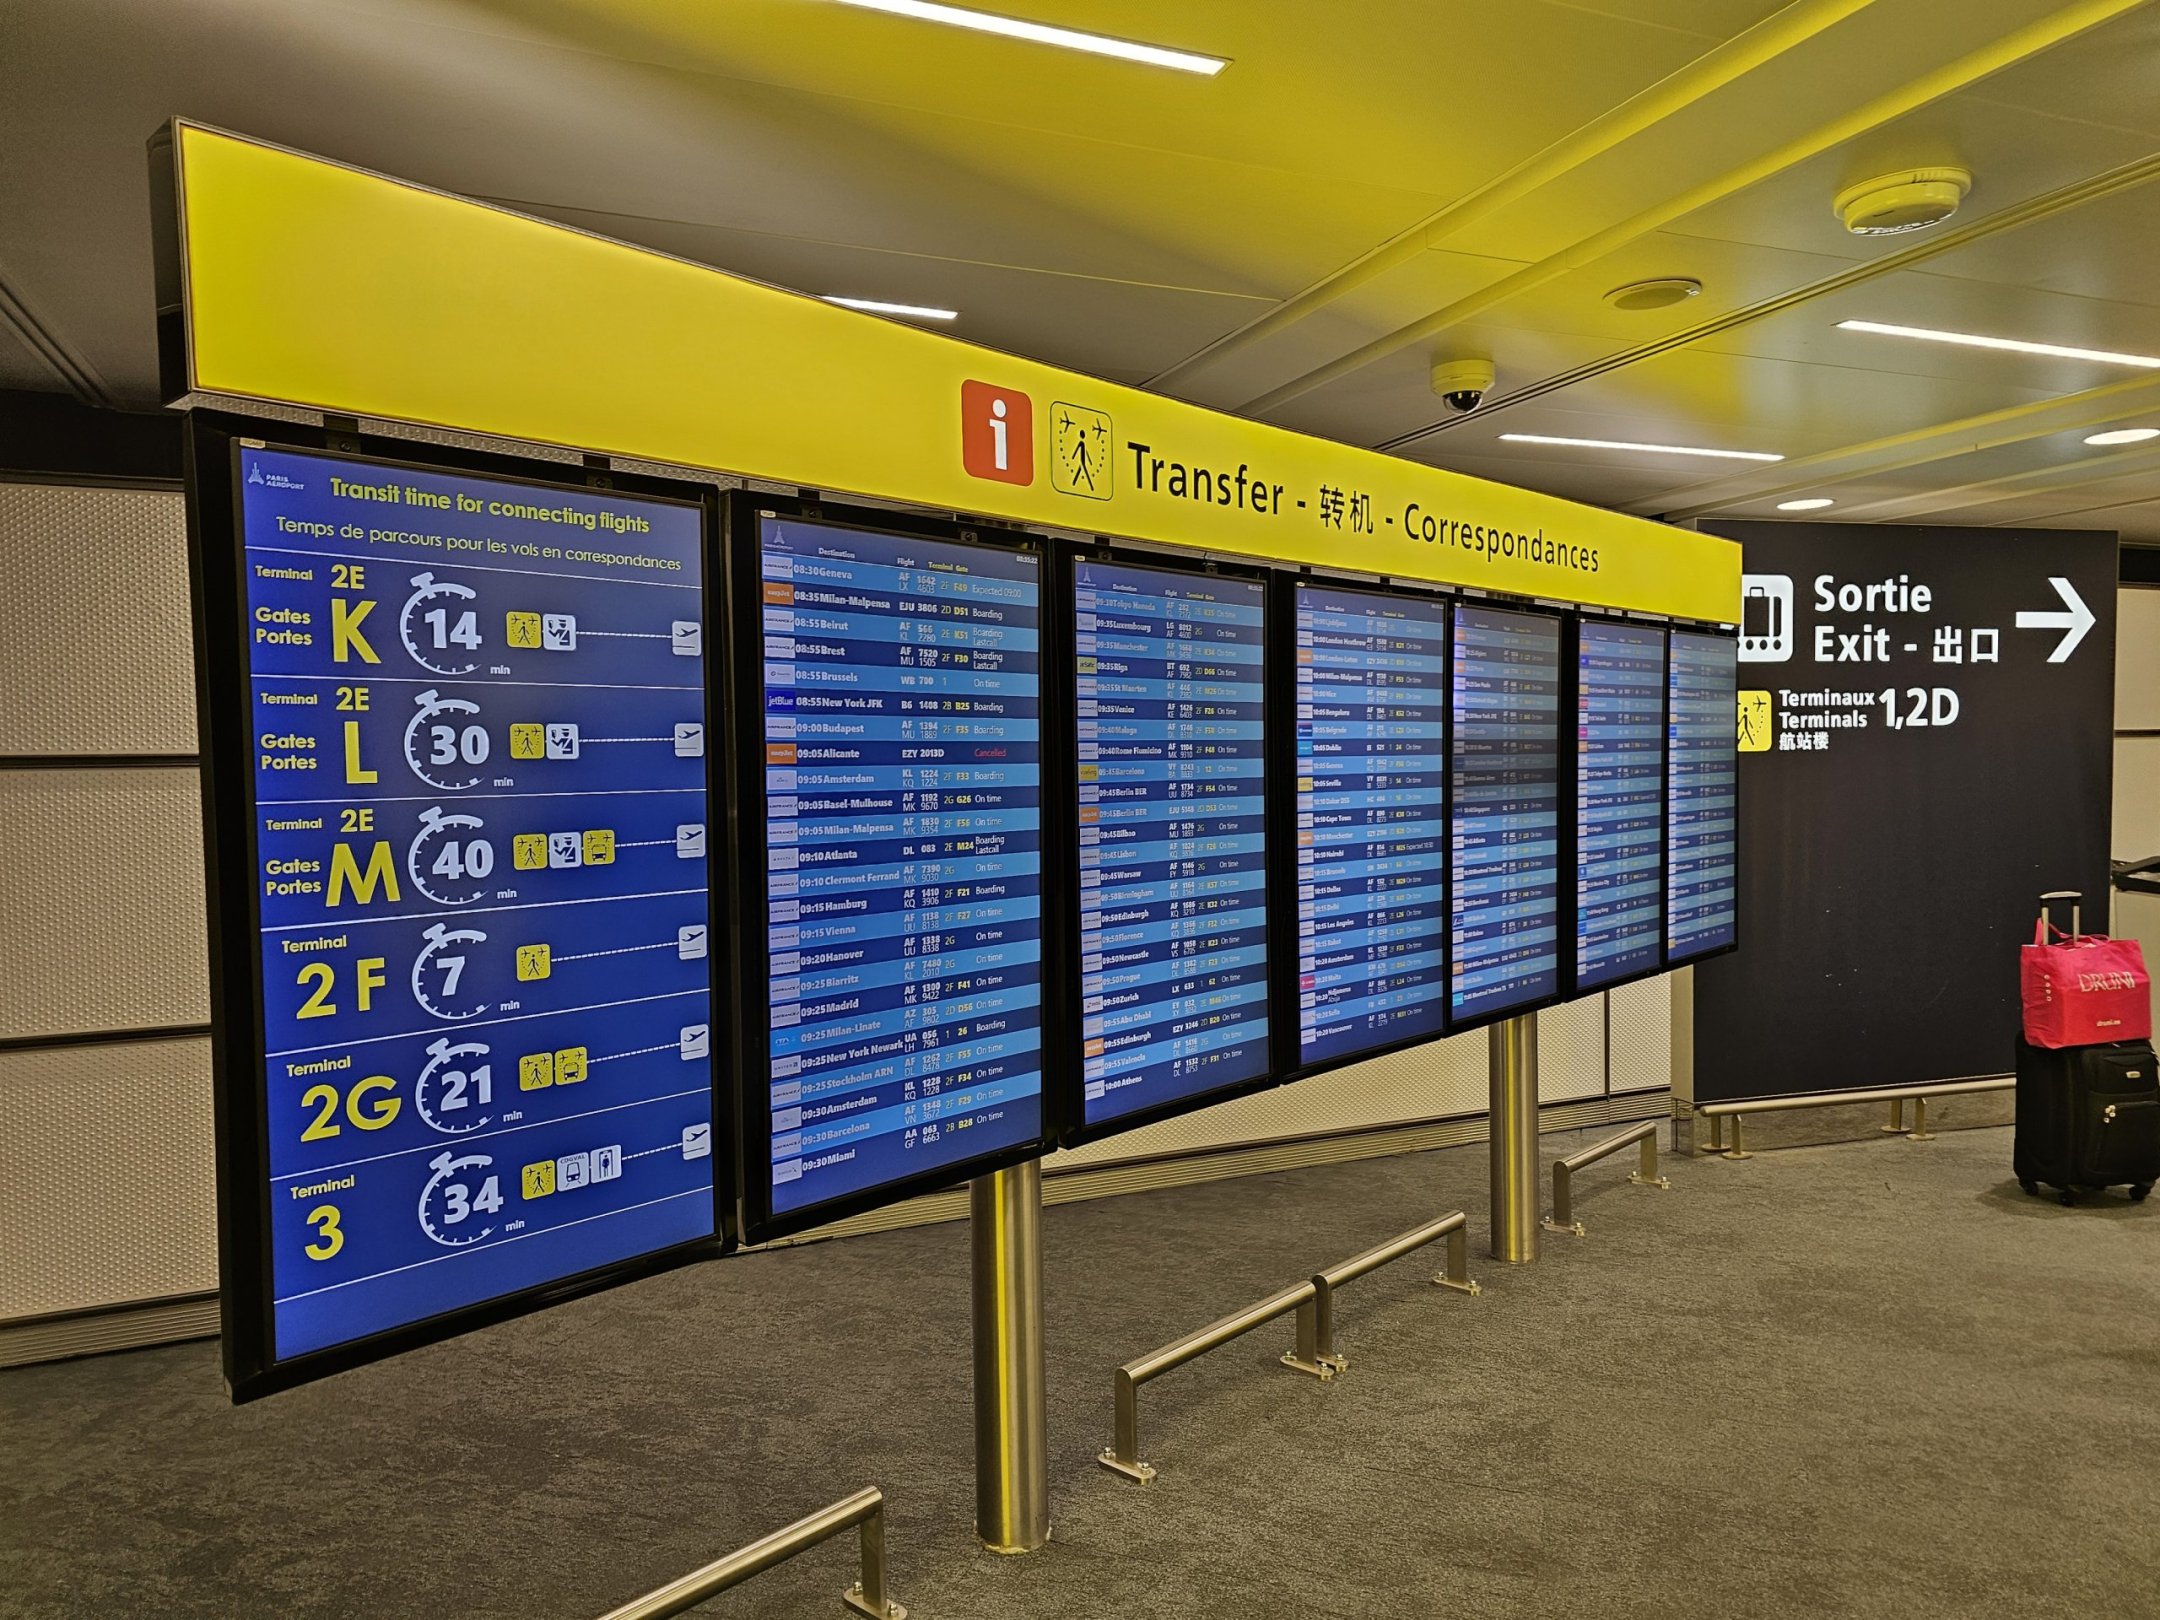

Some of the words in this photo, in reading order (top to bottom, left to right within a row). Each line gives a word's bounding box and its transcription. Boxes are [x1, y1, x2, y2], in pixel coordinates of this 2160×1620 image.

[266, 474, 289, 483] PARIS
[330, 476, 401, 503] Transit
[404, 486, 452, 511] time
[456, 493, 484, 513] for
[488, 500, 596, 530] connecting
[598, 511, 650, 534] flights
[1127, 441, 1284, 516] Transfer
[1319, 484, 1374, 535] 转机
[1404, 502, 1599, 573] Correspondances
[276, 516, 335, 538] Temps
[339, 523, 364, 539] de
[369, 529, 442, 547] parcours
[445, 537, 484, 551] pour
[486, 538, 508, 554] les
[510, 542, 539, 557] vols
[542, 547, 562, 559] en
[565, 549, 681, 571] correspondances
[818, 547, 856, 559] Destination
[255, 565, 314, 581] Terminal
[331, 564, 365, 590] 2E
[793, 564, 819, 576] 08:30
[818, 567, 853, 580] Geneva
[1814, 574, 1932, 612] Sortie
[793, 590, 820, 602] 08:35
[819, 593, 891, 609] Milan-Malpensa
[917, 602, 938, 613] 3806
[940, 604, 952, 614] 2D
[953, 606, 969, 616] D51
[972, 607, 1003, 622] Boarding
[255, 606, 311, 625] Gates
[794, 617, 820, 628] 08:55
[820, 619, 849, 631] Beirut
[331, 598, 381, 664] K
[424, 608, 483, 650] 14
[1112, 620, 1152, 633] Luxembourg
[256, 628, 313, 646] Portes
[1814, 624, 1890, 662] Exit
[1933, 626, 1998, 664] 出口
[795, 643, 821, 655] 08:55
[820, 645, 846, 656] Brest
[490, 664, 511, 675] min
[795, 670, 822, 681] 08:55
[821, 671, 858, 682] Brussels
[260, 692, 319, 705] Terminal
[336, 687, 370, 711] 2E
[796, 697, 822, 707] 08:55
[821, 697, 843, 707] New
[843, 697, 866, 708] York
[866, 698, 883, 708] JFK
[901, 700, 913, 710] B6
[918, 700, 939, 710] 1408
[955, 701, 970, 711] B25
[973, 702, 1004, 714] Boarding
[1779, 689, 1875, 706] Terminaux
[796, 723, 823, 733] 09:00
[822, 723, 865, 735] Budapest
[1779, 711, 1867, 729] Terminals
[260, 733, 316, 749] Gates
[430, 725, 490, 765] 30
[1779, 732, 1829, 751] 航站楼
[344, 720, 378, 785] L
[796, 748, 823, 759] 09:05
[822, 748, 860, 759] Alicante
[902, 749, 919, 759] EZY
[919, 748, 945, 758] 2013D
[261, 754, 317, 770] Portes
[493, 777, 514, 787] min
[797, 774, 823, 784] 09:05
[823, 773, 875, 784] Amsterdam
[797, 800, 824, 810] 09:05
[823, 798, 893, 809] Basel-Mulhouse
[265, 817, 323, 831] Terminal
[340, 808, 374, 833] 2E
[798, 826, 824, 836] 09:05
[824, 823, 894, 835] Milan-Malpensa
[432, 839, 494, 880] 40
[799, 851, 825, 862] 09:10
[824, 850, 858, 861] Atlanta
[266, 858, 321, 875] Gates
[326, 839, 401, 907] M
[266, 879, 322, 896] Portes
[799, 877, 824, 888] 09:10
[824, 874, 866, 886] Clermont
[867, 870, 900, 882] Ferrand
[497, 888, 518, 900] min
[799, 902, 825, 914] 09:15
[825, 899, 868, 912] Hamburg
[800, 927, 825, 940] 09:15
[825, 926, 856, 936] Vienna
[281, 934, 347, 953] Terminal
[800, 953, 826, 966] 09:20
[825, 950, 864, 963] Hanover
[436, 955, 466, 997] 7
[800, 979, 827, 991] 09:25
[825, 975, 859, 988] Biarritz
[500, 1000, 520, 1012] min
[1119, 992, 1140, 1004] Zurich
[800, 1004, 826, 1017] 09:25
[826, 998, 859, 1013] Madrid
[800, 1029, 826, 1043] 09:25
[826, 1021, 881, 1038] Milan-Linate
[801, 1055, 827, 1069] 09:25
[826, 1052, 848, 1064] New
[848, 1046, 870, 1059] York
[870, 1039, 904, 1055] Newark
[286, 1055, 351, 1077] Terminal
[440, 1064, 492, 1111] 21
[801, 1081, 827, 1094] 09:25
[826, 1071, 873, 1089] Stockholm
[874, 1065, 894, 1079] ARN
[1120, 1075, 1143, 1087] Athens
[301, 1075, 401, 1142] 2G
[503, 1110, 523, 1123] min
[801, 1106, 827, 1120] 09:30
[826, 1096, 878, 1115] Amsterdam
[801, 1131, 827, 1146] 09:30
[826, 1122, 870, 1140] Barcelona
[802, 1156, 828, 1171] 09:30
[827, 1148, 856, 1165] Miami
[290, 1174, 355, 1200] Terminal
[444, 1175, 504, 1224] 34
[305, 1205, 344, 1261] 3
[505, 1219, 525, 1232] min
